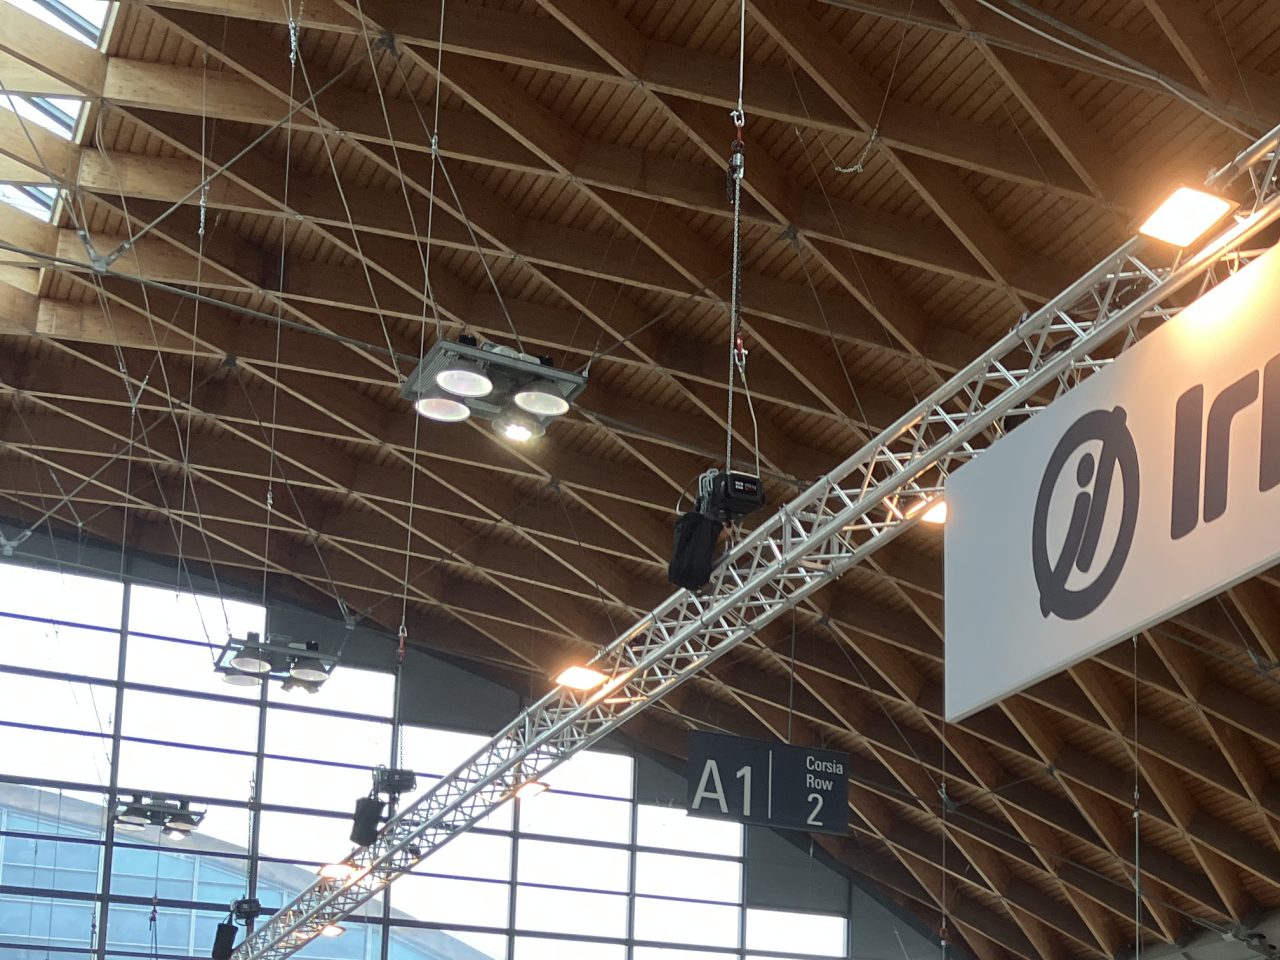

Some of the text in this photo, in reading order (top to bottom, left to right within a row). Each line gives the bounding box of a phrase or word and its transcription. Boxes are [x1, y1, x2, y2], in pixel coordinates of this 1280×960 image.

[806, 755, 844, 775] Corsia
[691, 758, 751, 817] A1
[806, 773, 833, 791] Row
[806, 792, 824, 827] 2
